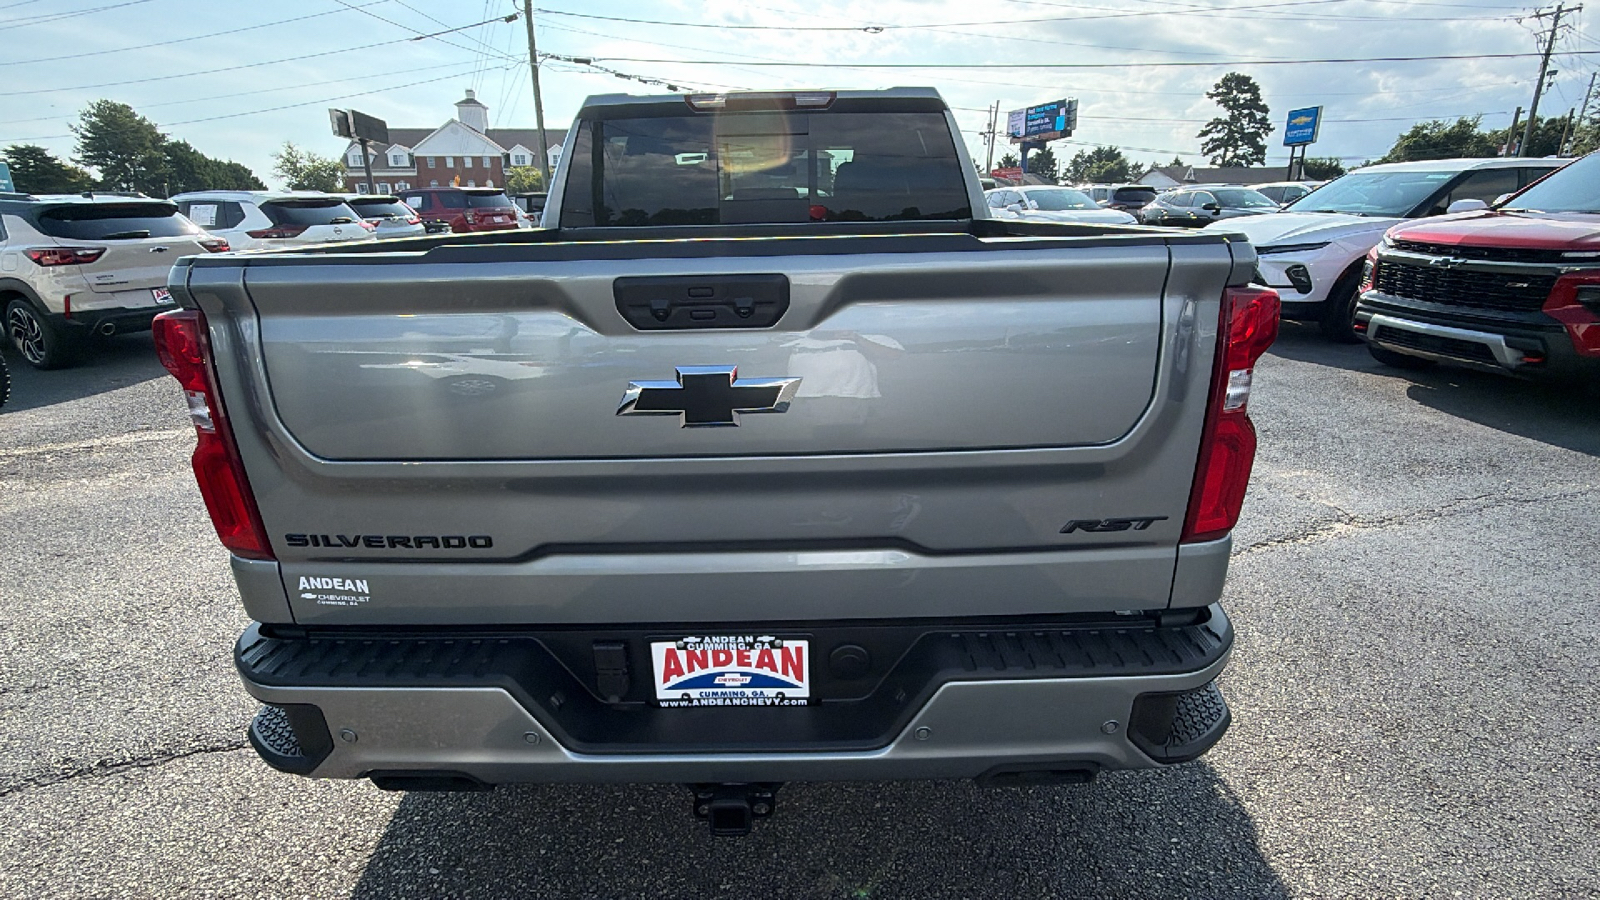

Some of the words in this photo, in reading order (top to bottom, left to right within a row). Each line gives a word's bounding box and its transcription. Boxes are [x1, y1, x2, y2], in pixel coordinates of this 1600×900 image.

[1059, 516, 1169, 533] RST
[285, 533, 493, 549] SILVERADO
[298, 576, 370, 594] ANDEAN
[317, 594, 371, 603] CHEVROLET
[703, 636, 754, 644] ANDEAN
[663, 646, 804, 685] ANDEAN
[699, 690, 749, 698] CUMMING,
[659, 698, 808, 708] www.ANDEANCHEVY.com
